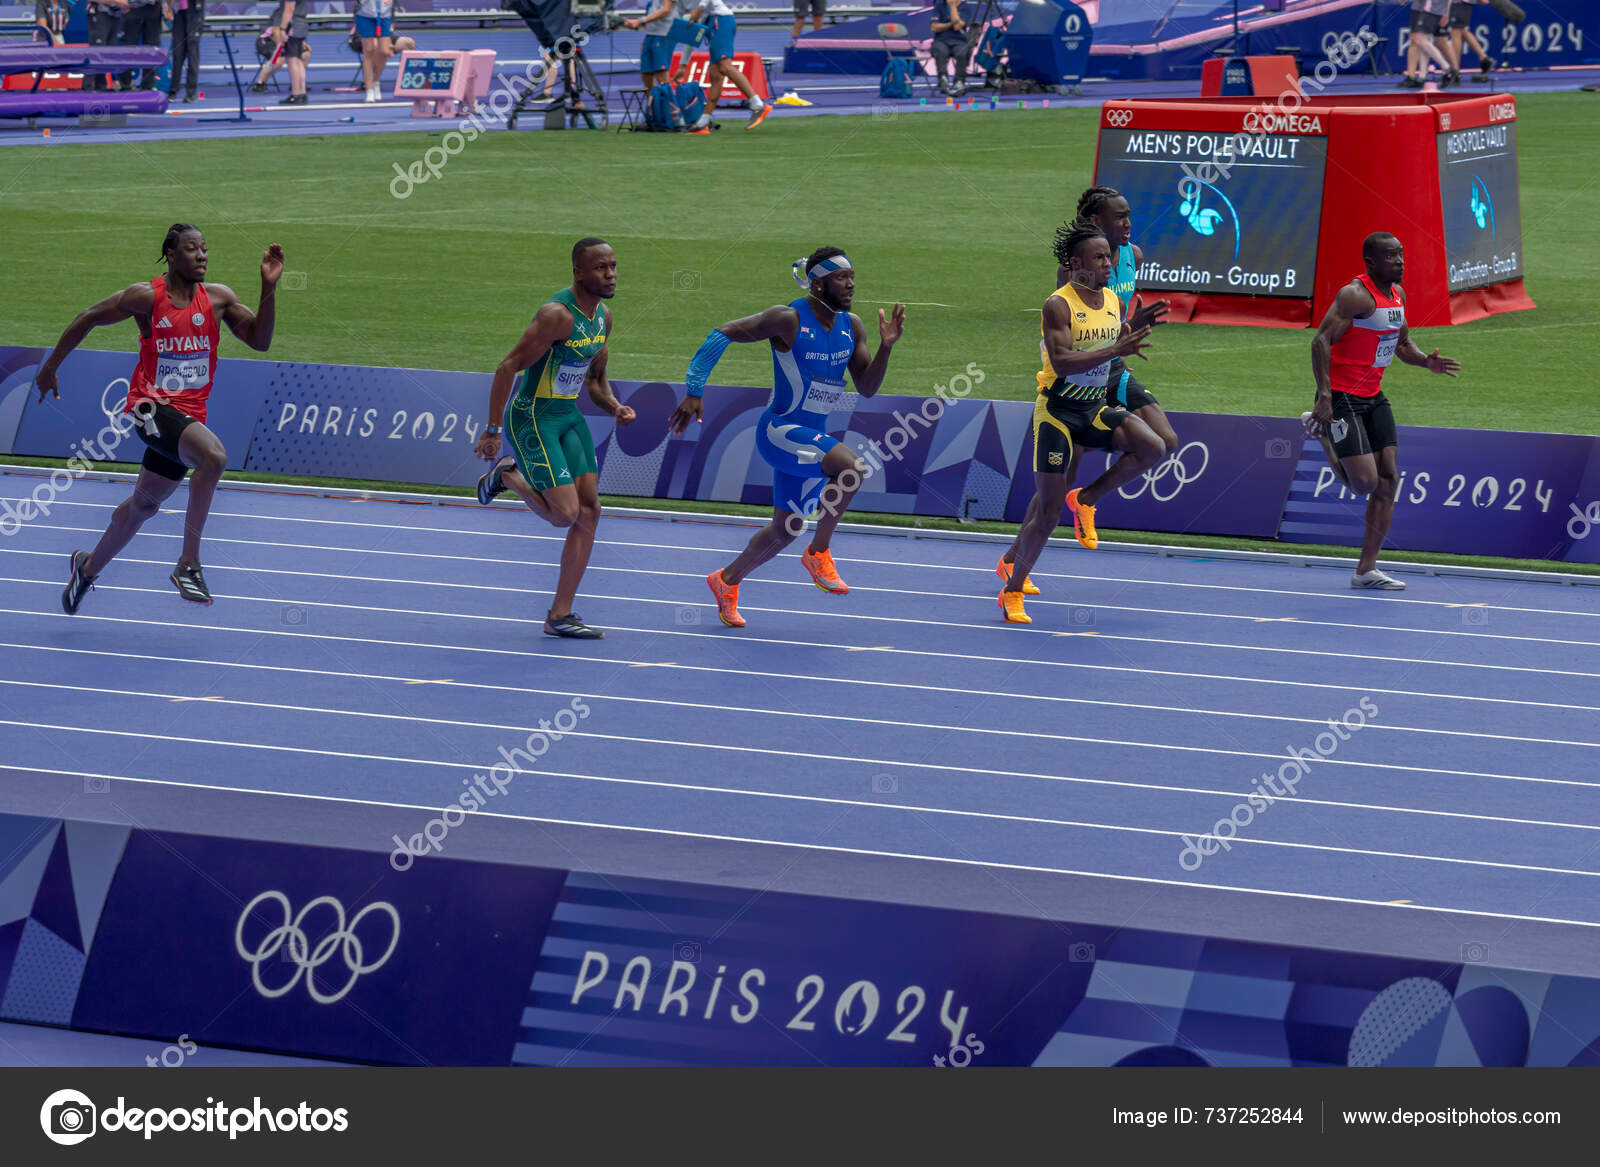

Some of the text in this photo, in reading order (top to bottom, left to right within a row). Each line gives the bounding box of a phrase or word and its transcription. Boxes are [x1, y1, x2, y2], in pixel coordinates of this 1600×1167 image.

[1502, 22, 1583, 52] 2024
[1262, 113, 1323, 134] OMEGA
[1126, 133, 1300, 159] MEN'S POLE VAULT
[1228, 265, 1278, 294] Group
[1284, 269, 1297, 288] B
[156, 335, 211, 353] GUYANA
[805, 348, 850, 361] BRITISH VIRGIN
[387, 410, 479, 444] 2024
[1337, 424, 1344, 435] 1
[1443, 474, 1553, 513] 2024
[786, 974, 969, 1048] 2024
